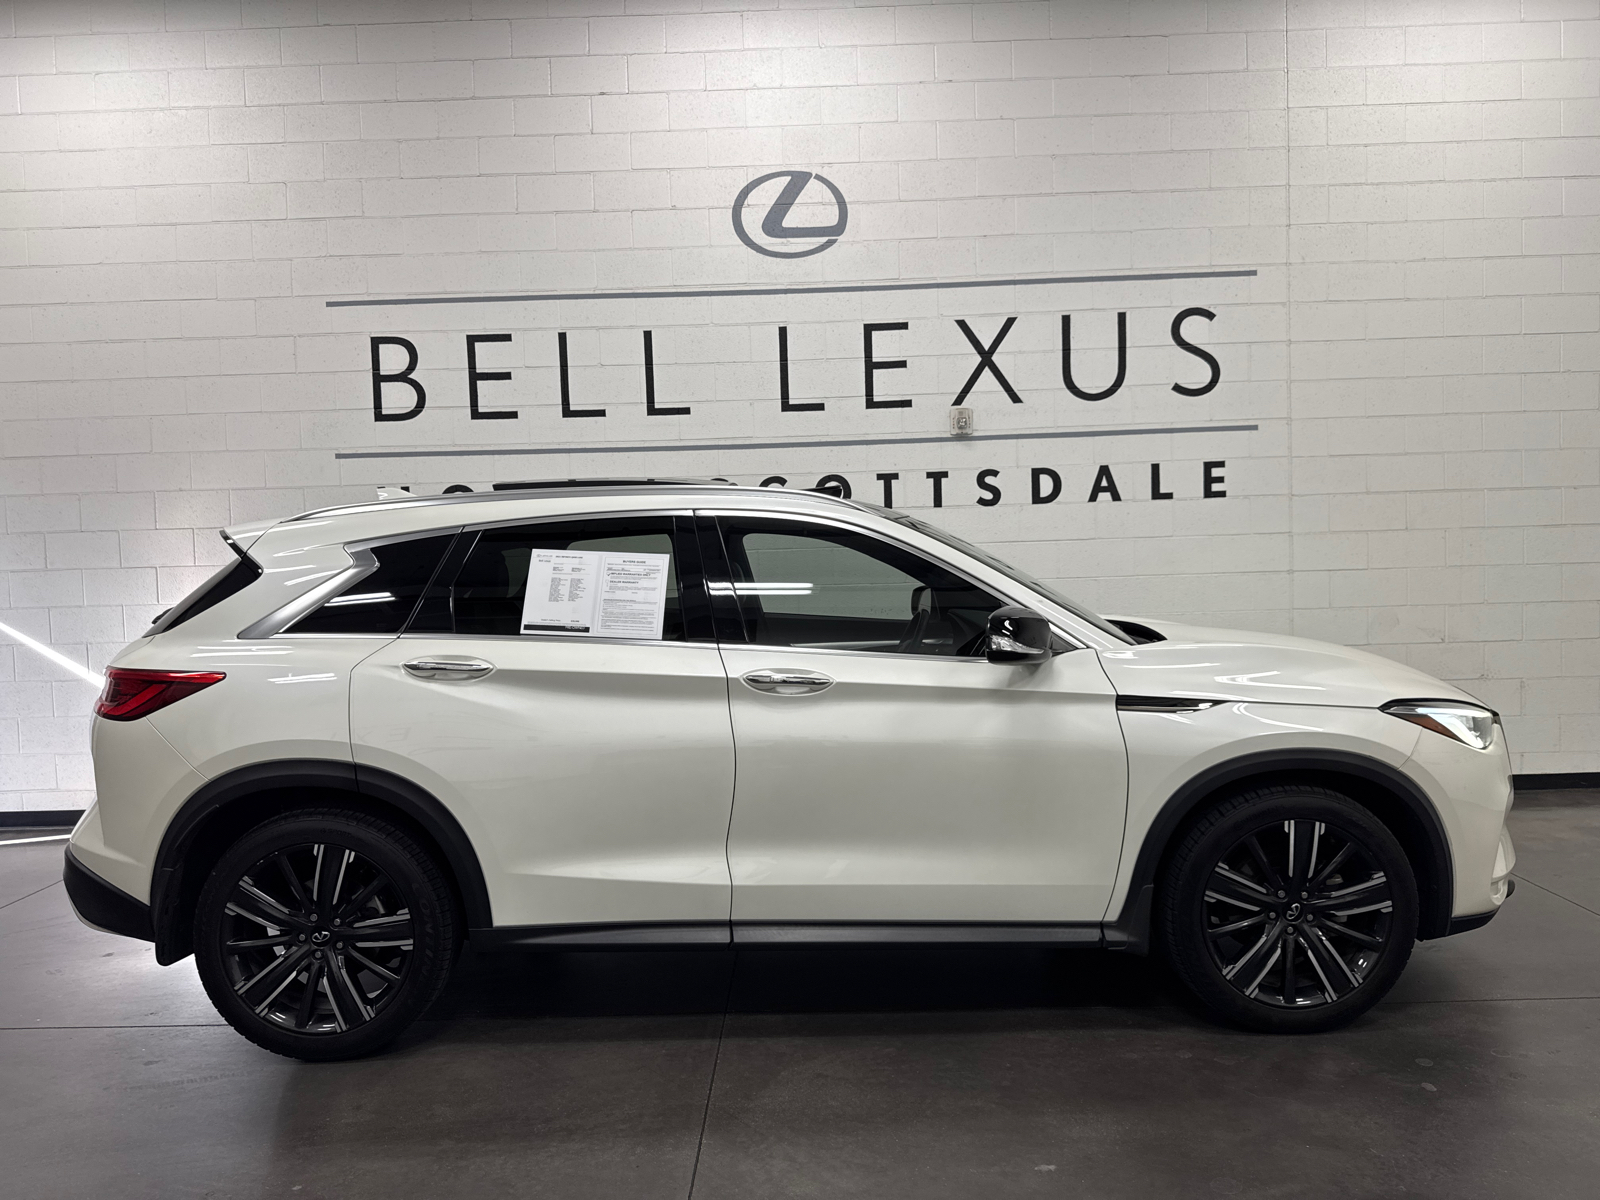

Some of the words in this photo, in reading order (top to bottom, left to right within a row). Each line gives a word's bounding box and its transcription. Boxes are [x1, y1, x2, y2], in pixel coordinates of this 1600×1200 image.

[370, 331, 690, 422] BELL
[779, 307, 1220, 412] LEXUS
[711, 461, 1226, 509] OTTSDALE
